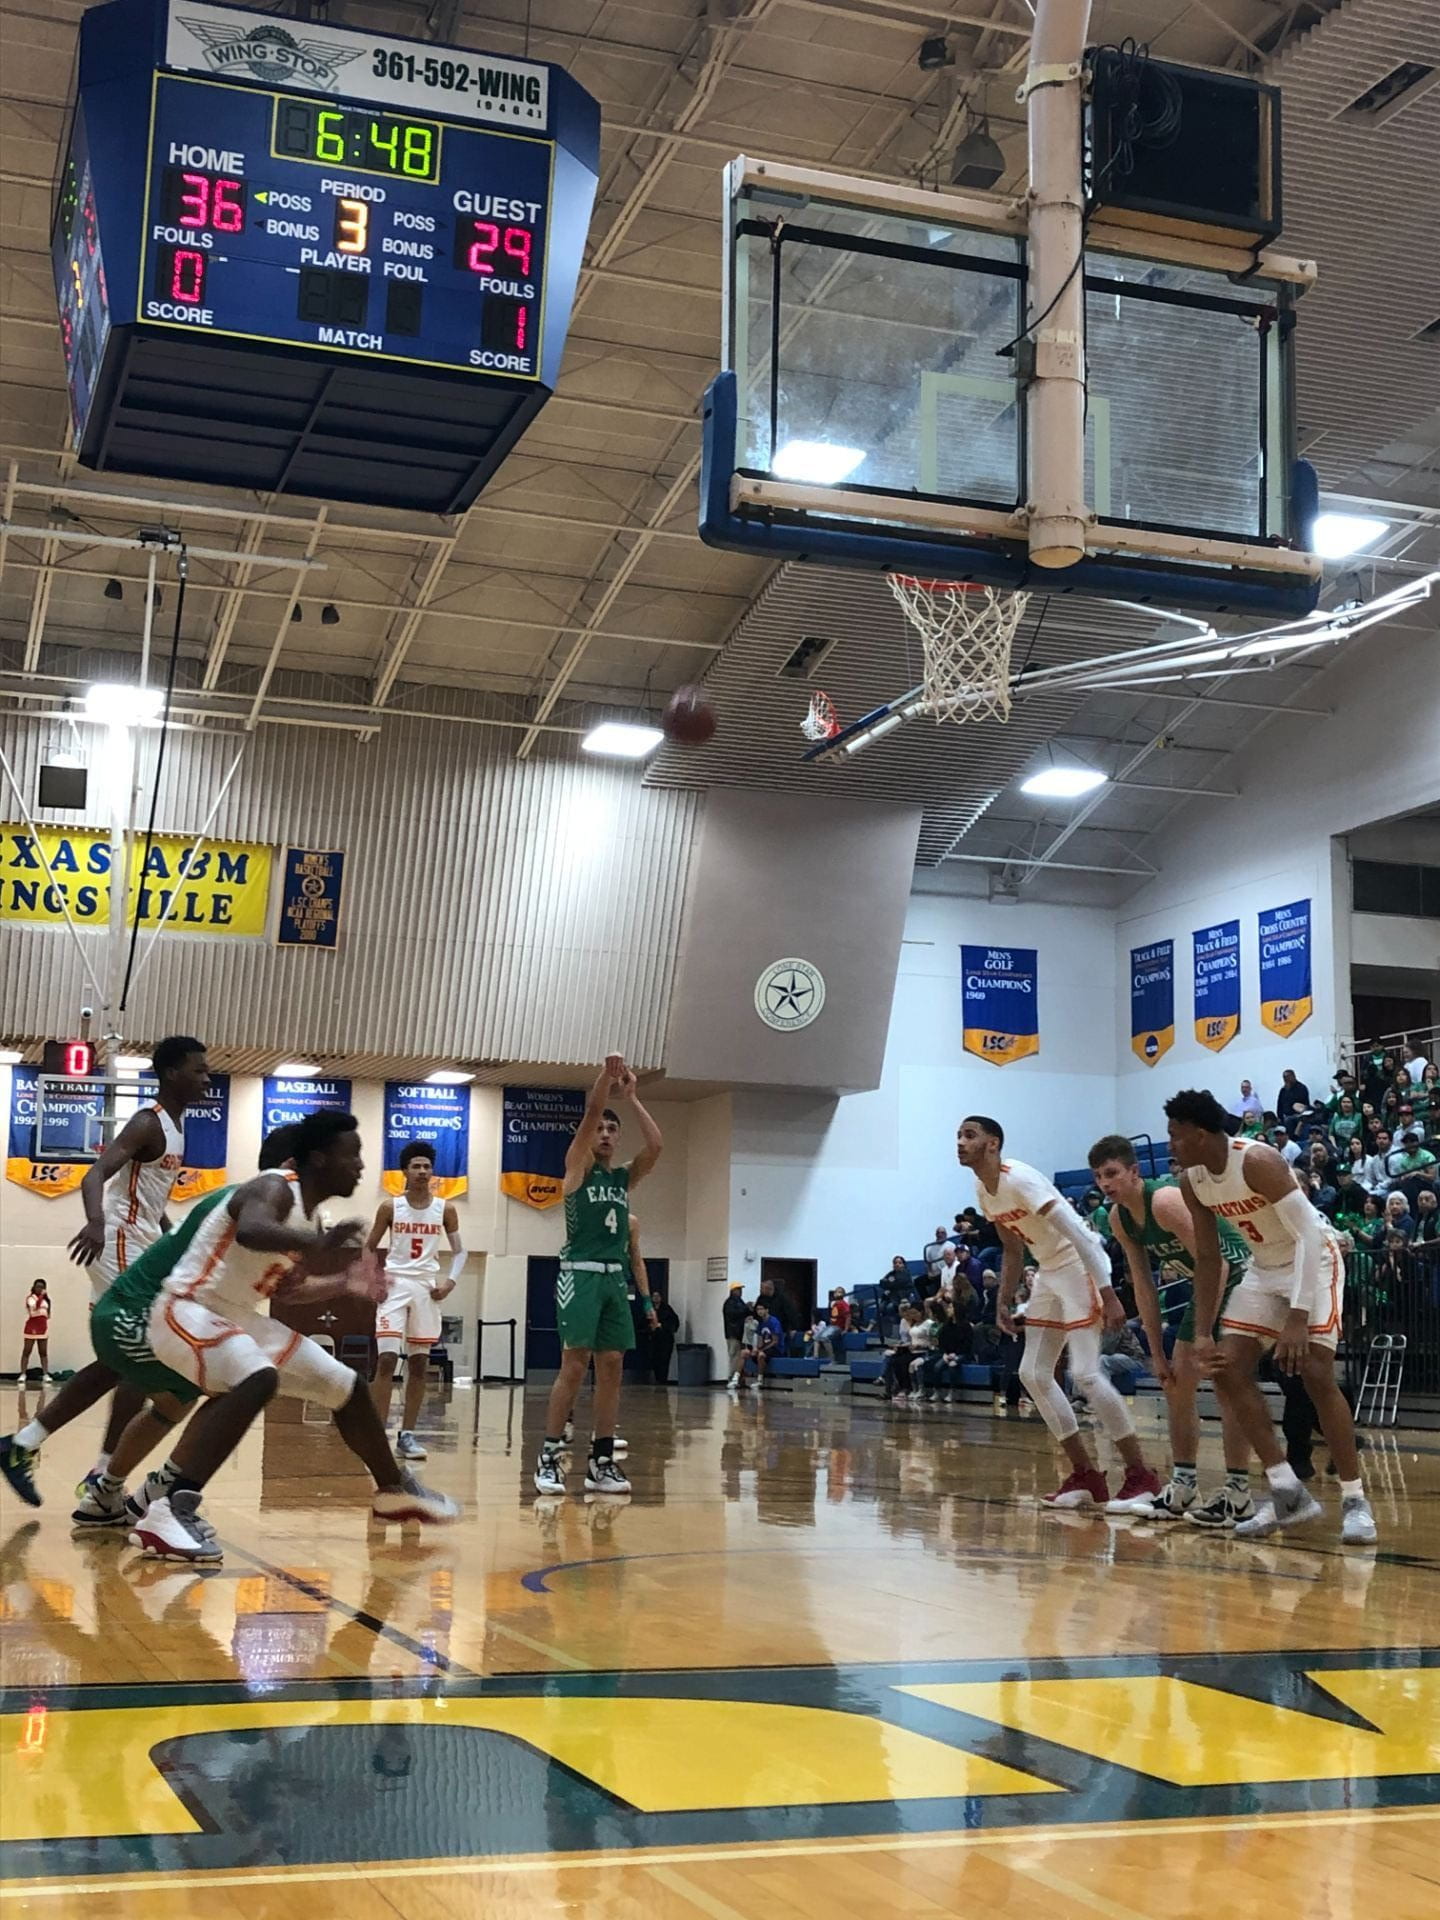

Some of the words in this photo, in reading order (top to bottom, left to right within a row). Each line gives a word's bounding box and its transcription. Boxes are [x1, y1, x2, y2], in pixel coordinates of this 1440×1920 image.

[372, 49, 541, 105] 361-592-WING
[316, 111, 432, 177] 6:48
[169, 142, 245, 175] HOME
[180, 173, 242, 232] 36
[268, 191, 312, 212] POSS
[320, 179, 386, 203] PERIOD
[453, 190, 542, 224] GUEST
[266, 218, 320, 241] BONUS
[336, 199, 369, 253] 3
[393, 211, 435, 232] POSS
[153, 225, 213, 248] FOULS
[469, 220, 532, 276] 29
[300, 247, 371, 273] PLAYER
[382, 237, 434, 260] BONUS
[172, 249, 203, 303] 0
[383, 262, 428, 283] FOUL
[480, 277, 535, 299] FOULS
[146, 301, 213, 325] SCORE
[318, 326, 383, 351] MATCH
[516, 306, 528, 350] 1
[469, 349, 531, 372] SCORE
[0, 833, 112, 874] XAS
[140, 845, 250, 885] A&M
[984, 959, 1014, 970] GOLF
[967, 975, 1032, 993] CHAMPIONS
[70, 1045, 89, 1075] 0
[276, 1080, 338, 1094] BASEBALL
[397, 1086, 458, 1100] SOFTBALL
[504, 1101, 532, 1111] BEACH
[391, 1113, 462, 1131] CHAMPIONS
[509, 1118, 578, 1135] CHAMPIONS
[507, 1134, 528, 1144] 2018
[393, 1221, 442, 1236] SPARTANS
[604, 1207, 618, 1234] 4
[1238, 1220, 1264, 1243] 3
[410, 1238, 424, 1260] 5
